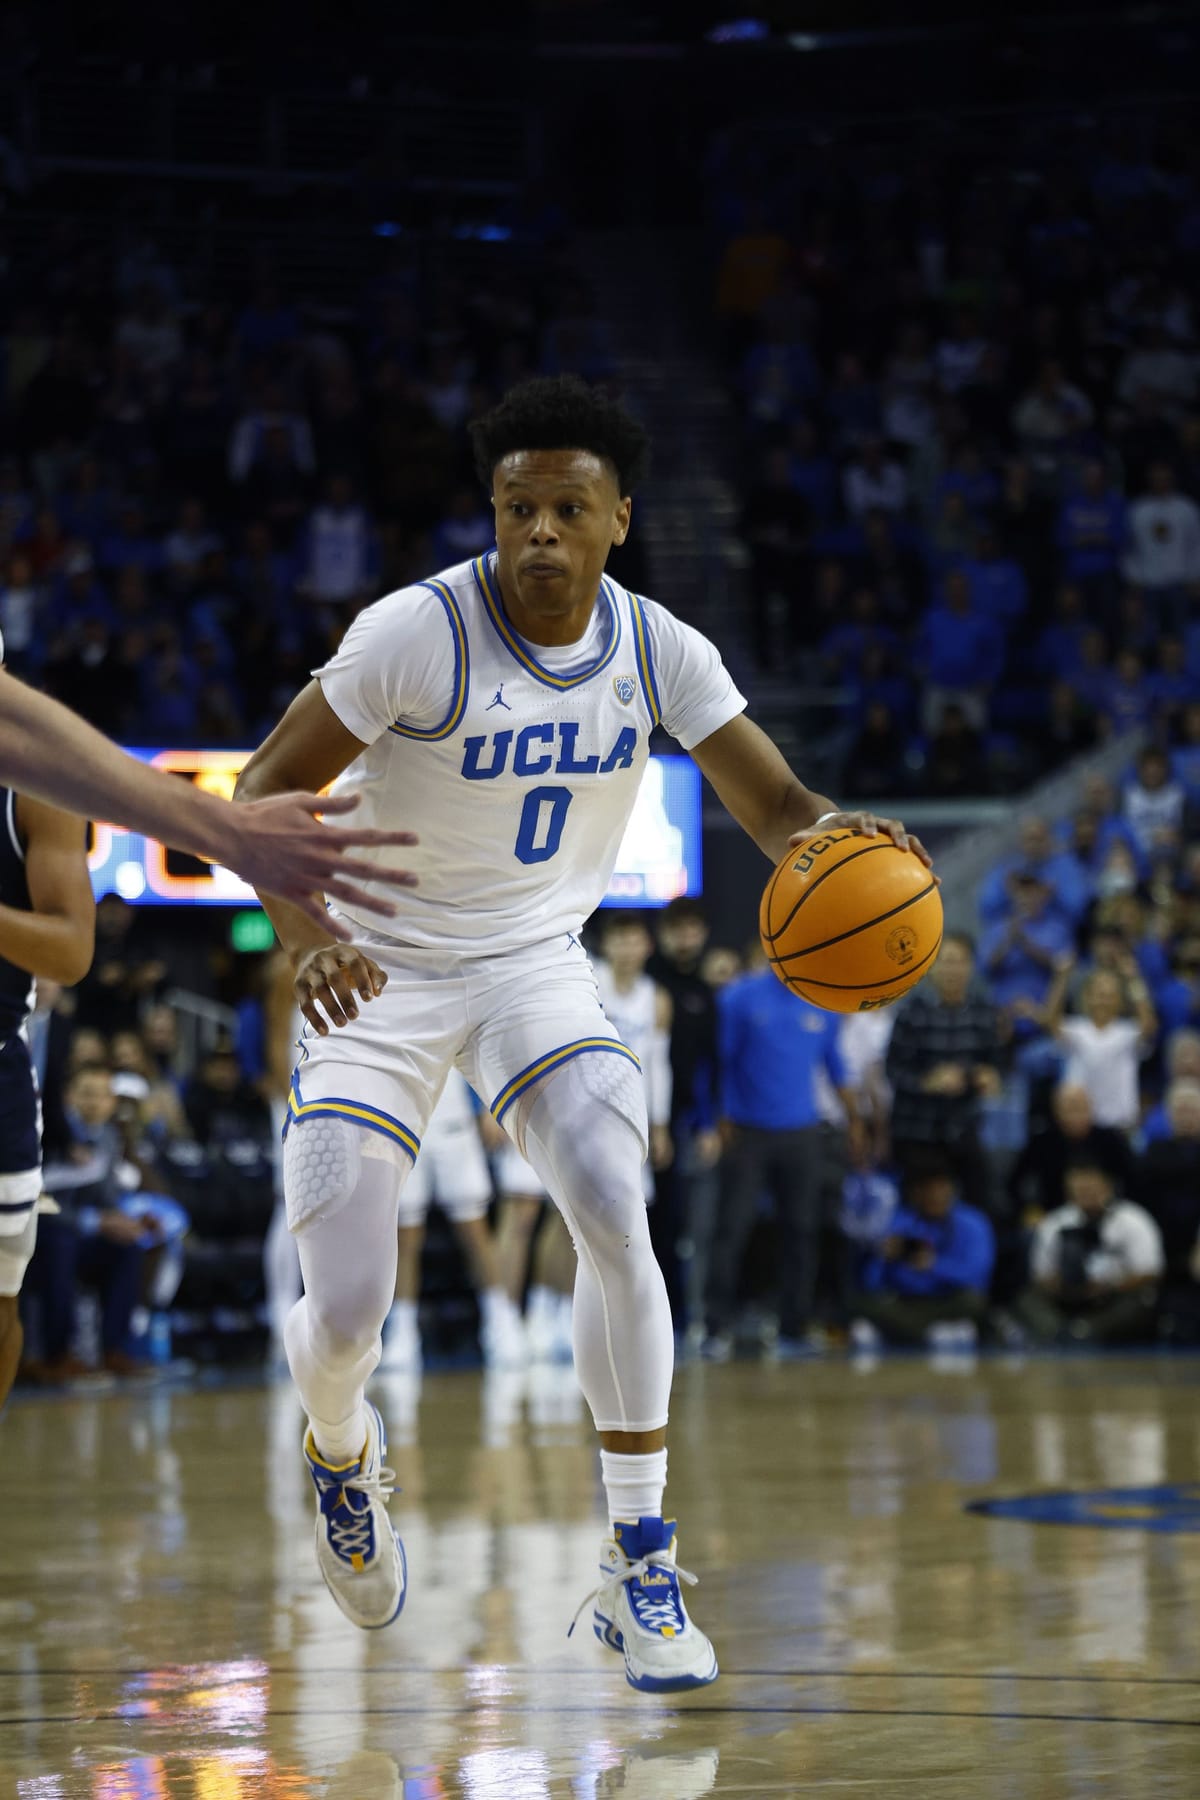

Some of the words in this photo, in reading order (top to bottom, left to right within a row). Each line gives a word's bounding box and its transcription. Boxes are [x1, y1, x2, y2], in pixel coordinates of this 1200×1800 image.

[620, 688, 631, 700] 12
[461, 722, 637, 780] UCLA
[514, 786, 573, 864] 0
